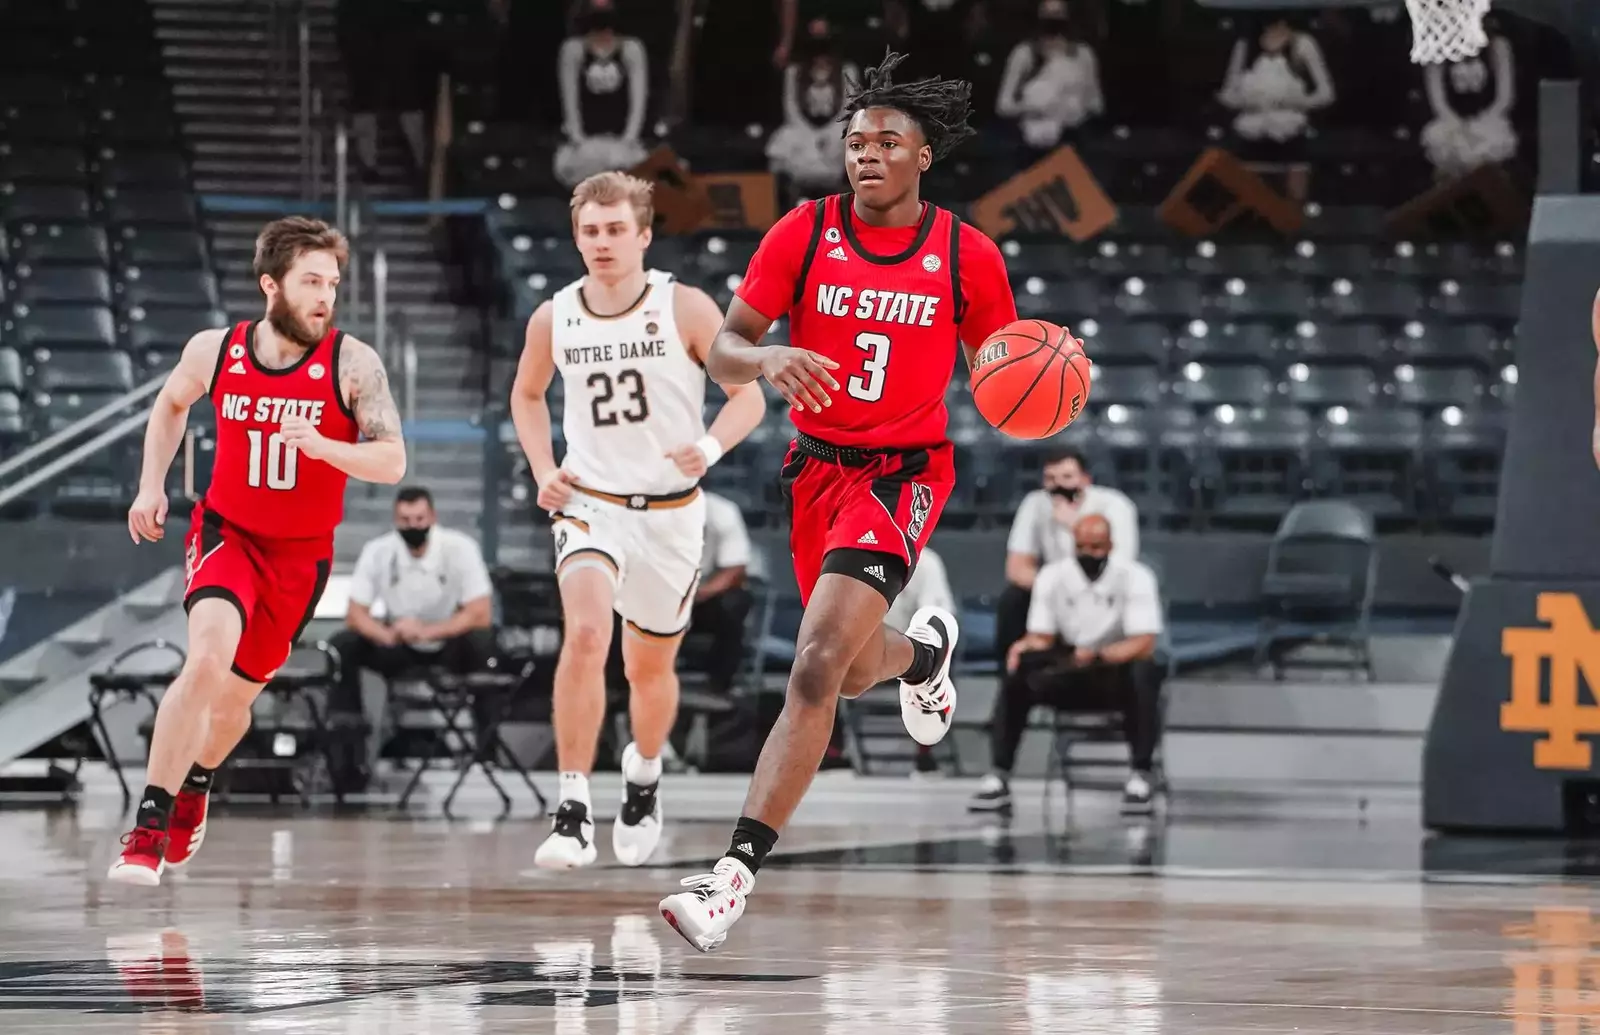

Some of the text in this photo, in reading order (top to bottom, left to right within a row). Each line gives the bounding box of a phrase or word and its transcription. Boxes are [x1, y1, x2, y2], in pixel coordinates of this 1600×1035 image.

[816, 284, 941, 328] NC STATE
[563, 339, 667, 365] NOTRE DAME
[846, 331, 891, 403] 3
[221, 393, 326, 427] NC STATE
[586, 368, 651, 428] 23
[246, 429, 299, 491] 10
[863, 566, 887, 583] adidas
